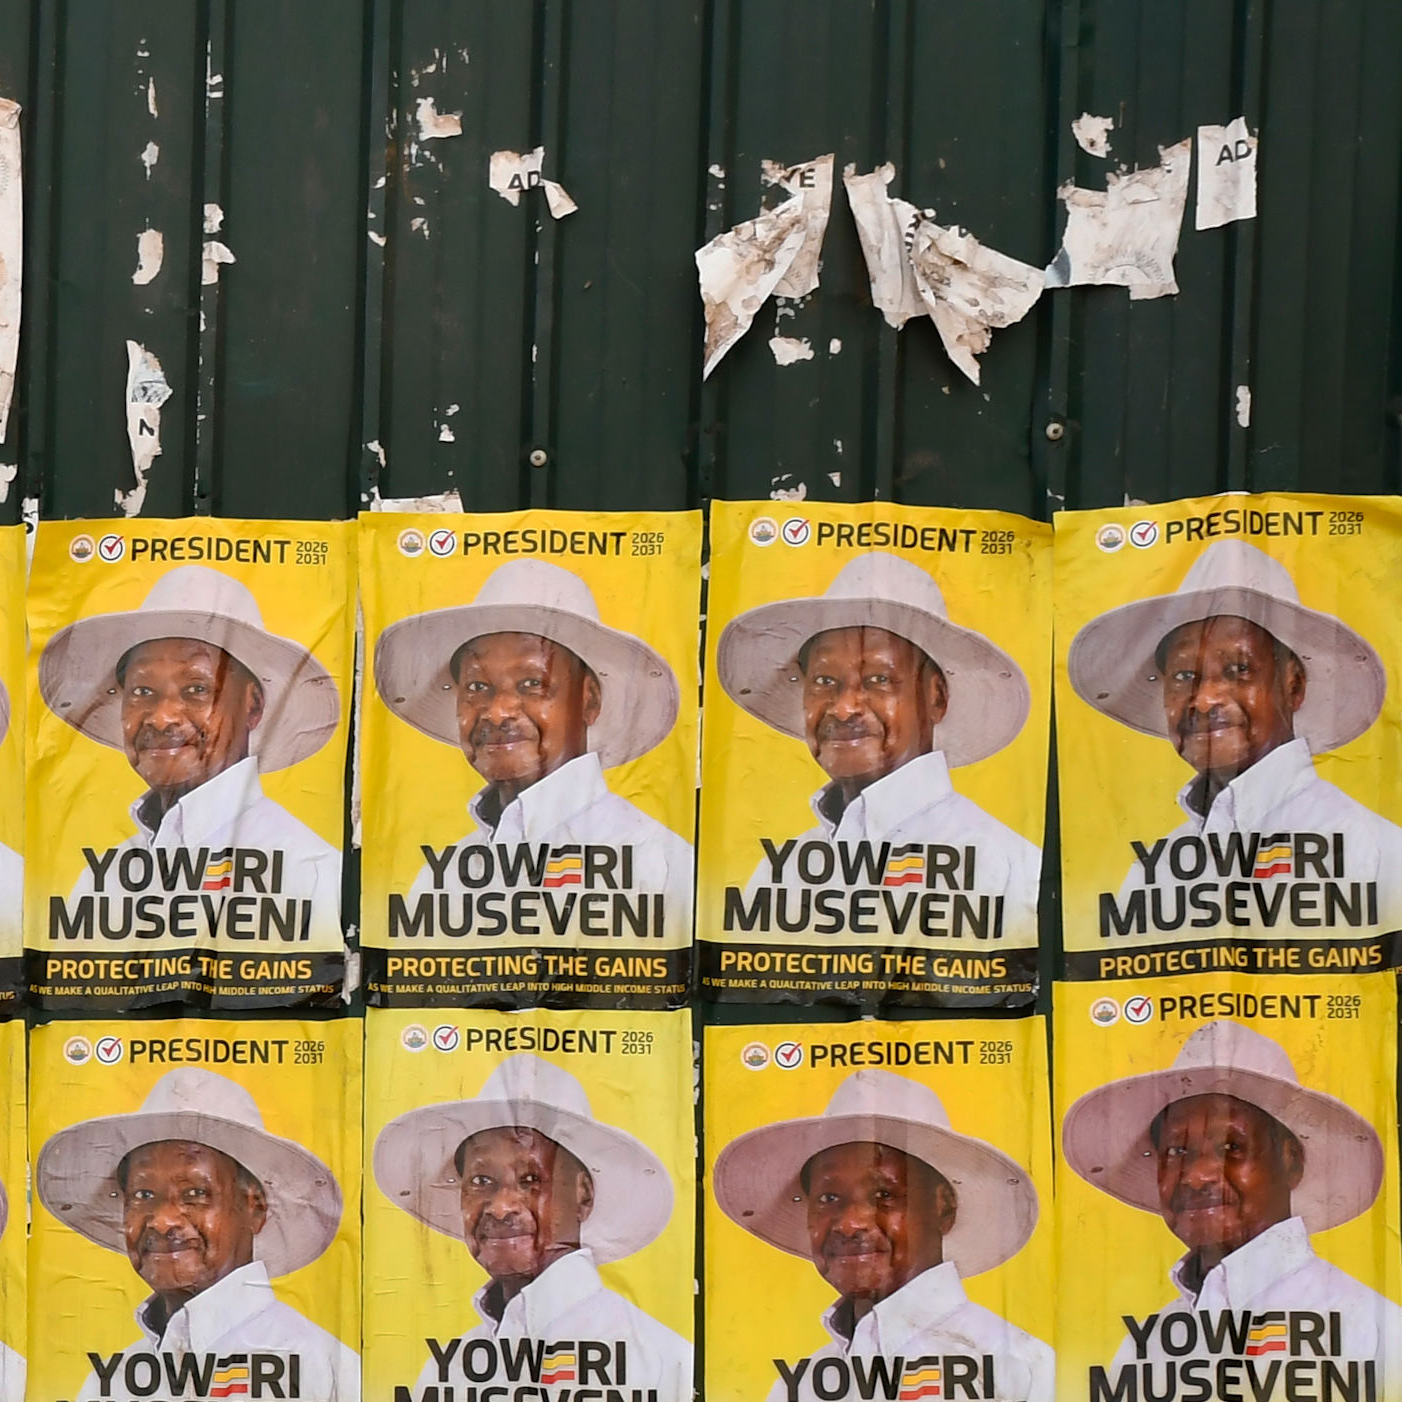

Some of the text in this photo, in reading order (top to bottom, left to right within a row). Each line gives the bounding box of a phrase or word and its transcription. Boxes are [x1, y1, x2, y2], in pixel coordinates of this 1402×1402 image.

[1329, 511, 1364, 522] 2026
[1166, 510, 1324, 545] PRESIDENT
[1329, 524, 1363, 536] 2031
[463, 529, 627, 556] PRESIDENT
[632, 532, 664, 543] 2026
[296, 542, 328, 553] 2026
[632, 544, 663, 556] 2031
[296, 553, 327, 565] 2031
[420, 842, 633, 889] YOWERI
[387, 892, 664, 938] MUSEVENI
[387, 955, 667, 979] PROTECTING THE GAINS
[1100, 945, 1382, 978] PROTECTING THE GAINS
[1160, 994, 1322, 1020] PRESIDENT
[1327, 995, 1361, 1007] 2026
[1327, 1007, 1360, 1019] 2031
[430, 1338, 626, 1385] YOWERI
